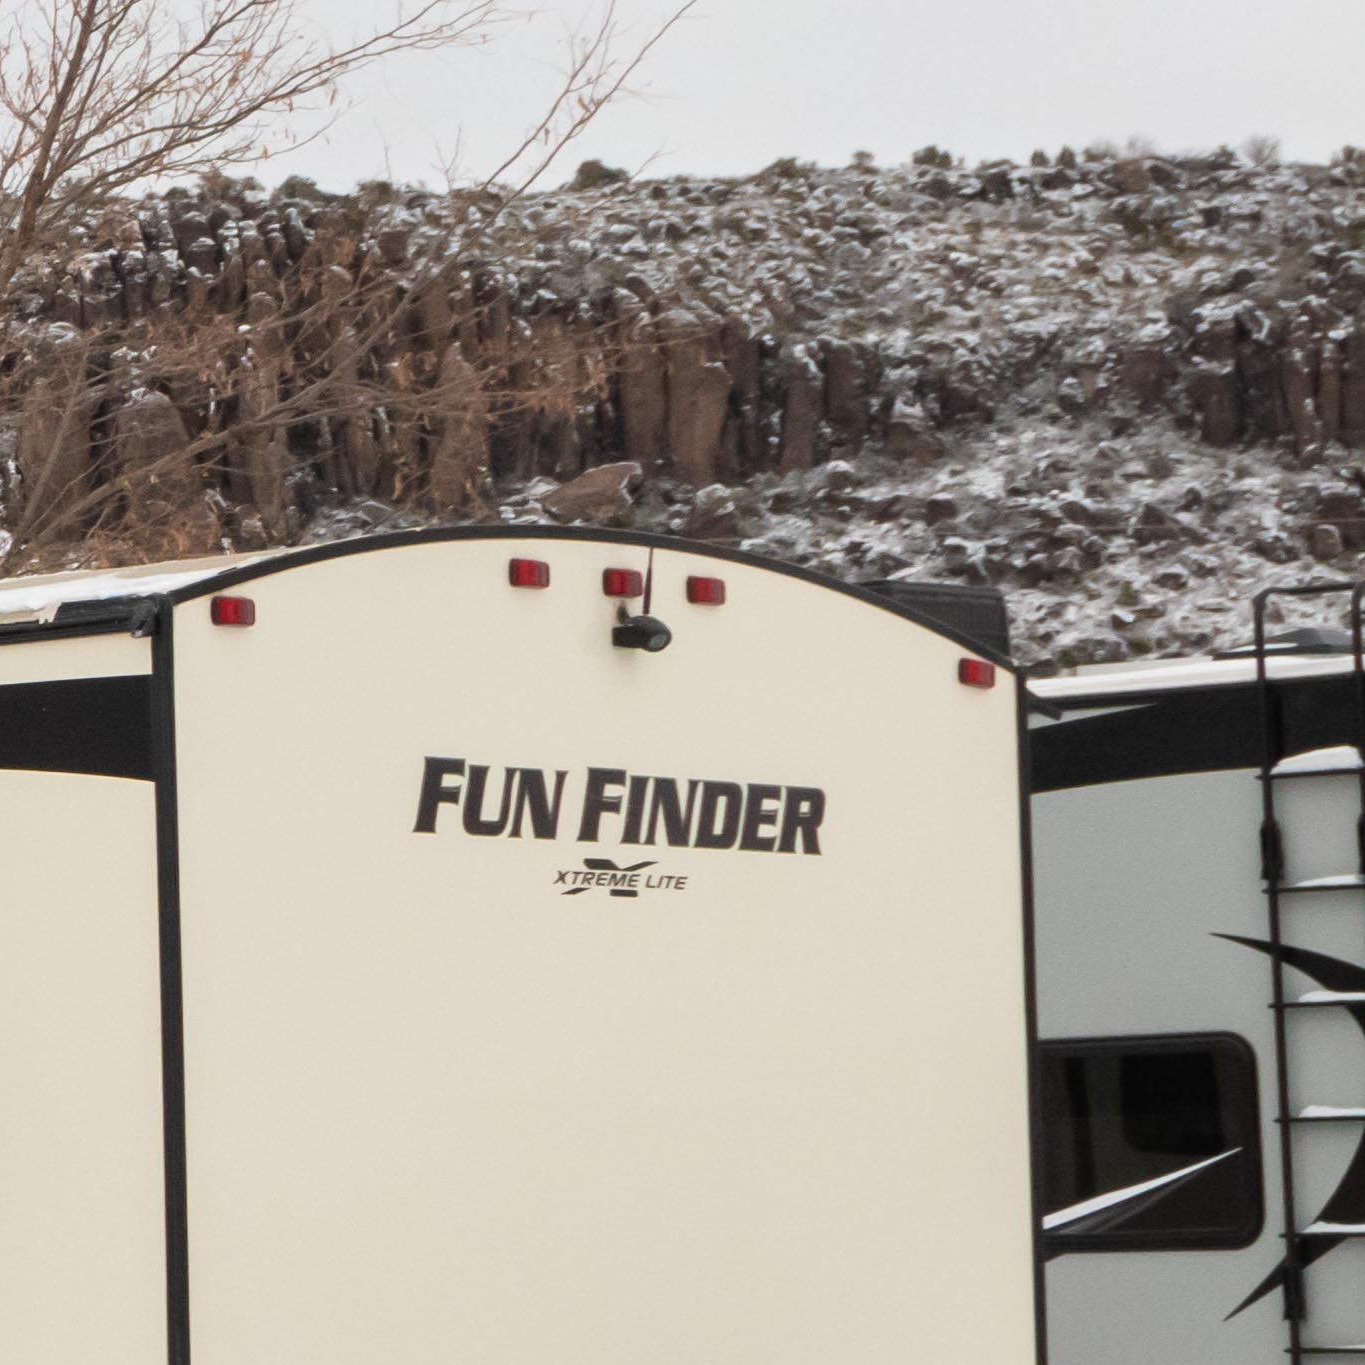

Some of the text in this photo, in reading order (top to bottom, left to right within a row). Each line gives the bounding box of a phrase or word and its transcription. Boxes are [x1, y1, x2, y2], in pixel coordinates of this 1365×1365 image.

[412, 755, 827, 856] FUN FINDER
[553, 869, 688, 891] XTREME LITE
